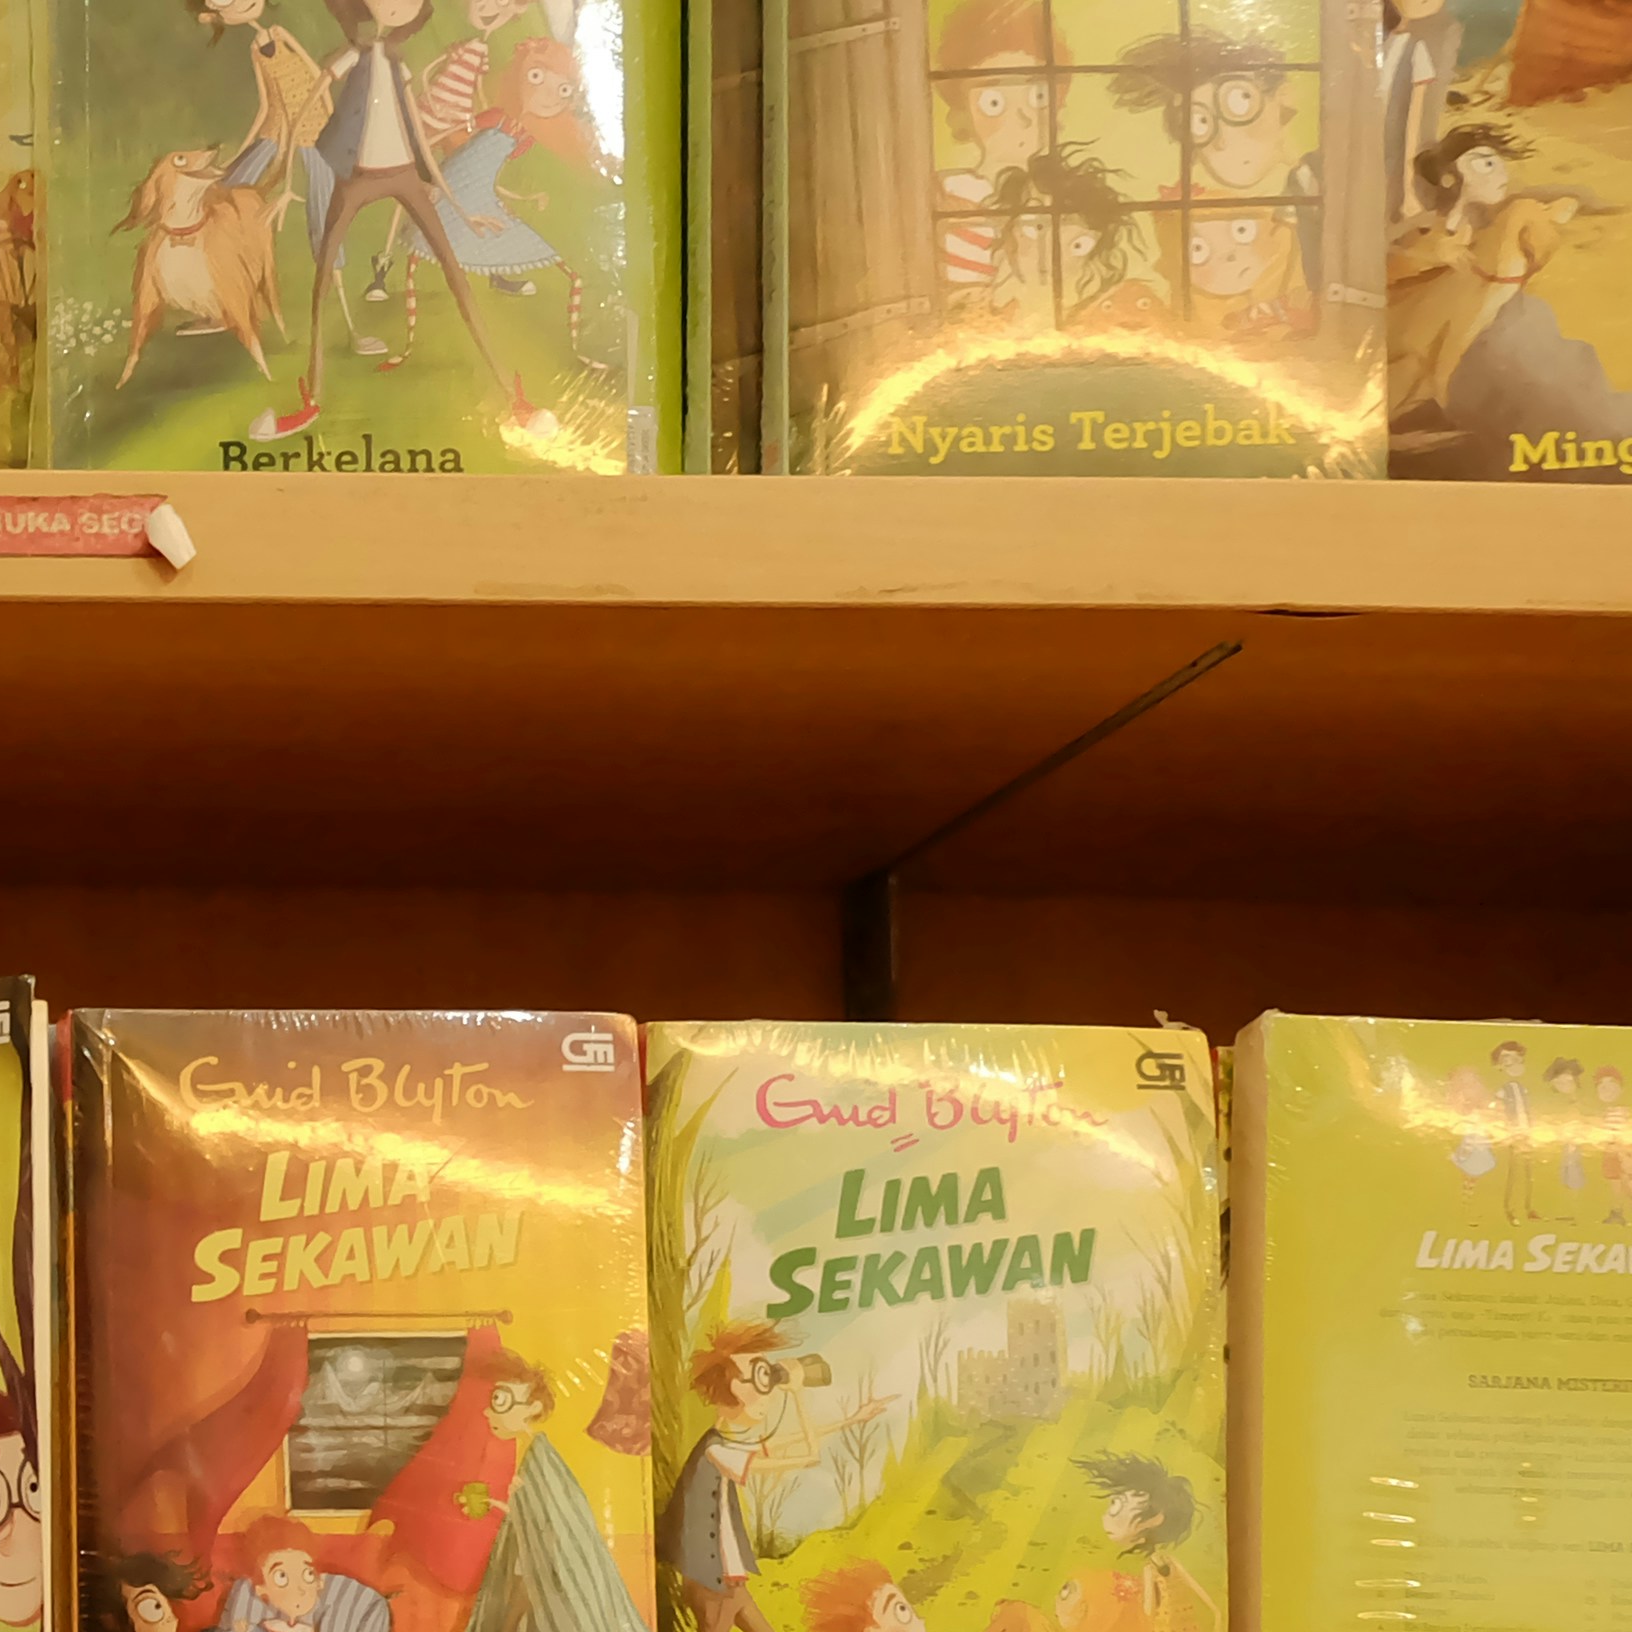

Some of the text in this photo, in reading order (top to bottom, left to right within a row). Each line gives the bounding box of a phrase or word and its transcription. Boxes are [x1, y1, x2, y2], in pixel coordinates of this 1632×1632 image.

[219, 434, 464, 472] Berkelana
[888, 405, 1296, 464] Nyaris Terjebak
[179, 1056, 534, 1126] Enid Blyton
[756, 1073, 896, 1129] Enid
[259, 1151, 433, 1223] LIMA
[835, 1166, 1007, 1240] LIMA
[191, 1210, 525, 1302] SEKAWAN
[766, 1227, 1096, 1320] SEKAWAN
[1416, 1230, 1632, 1275] LIMA SEKA
